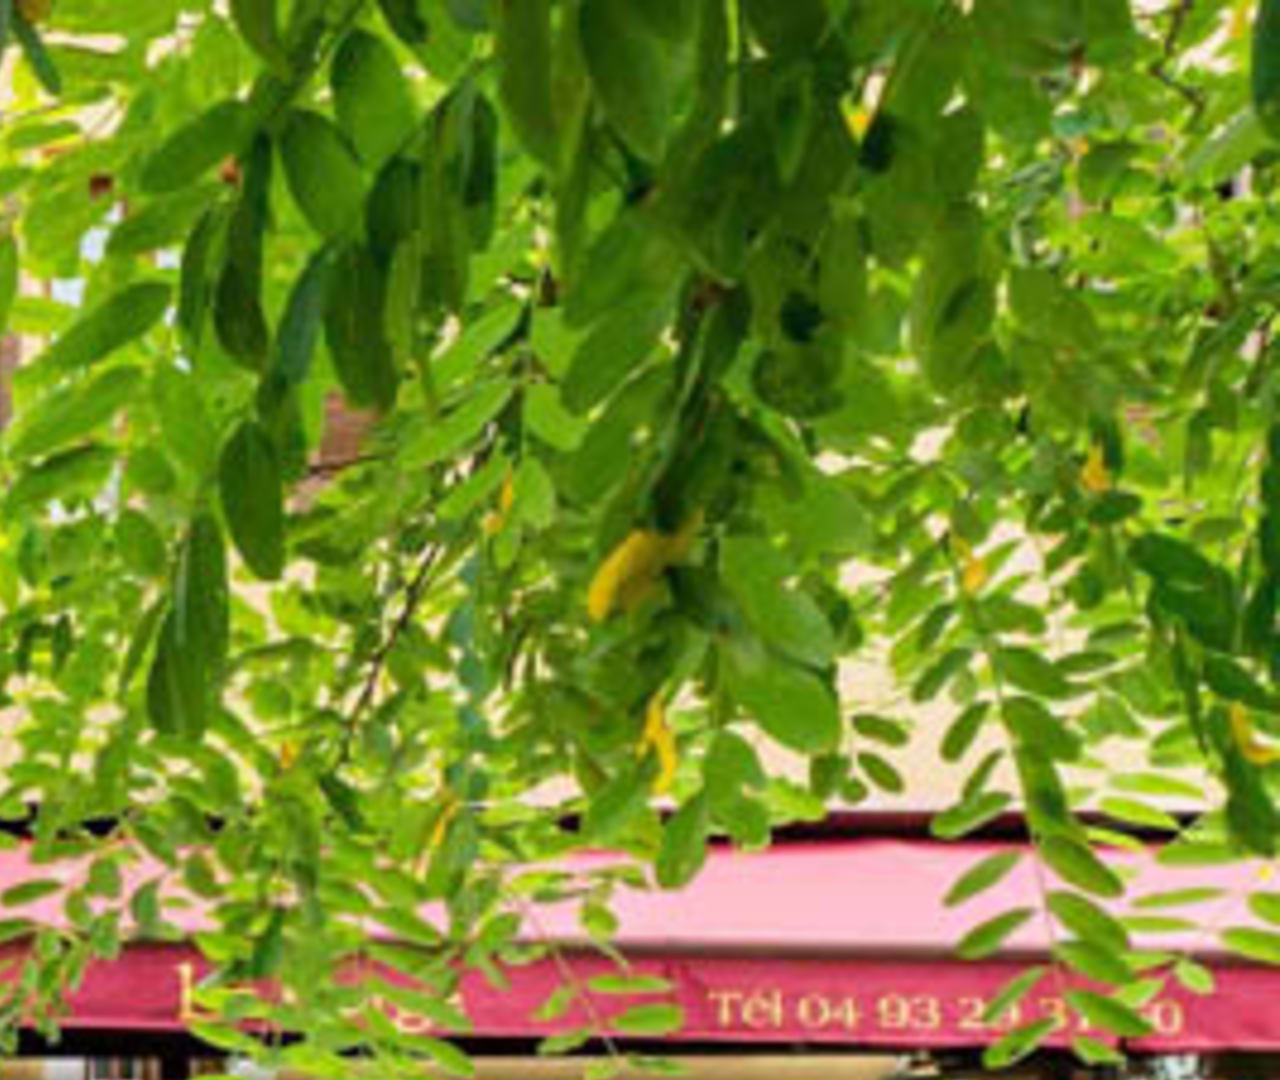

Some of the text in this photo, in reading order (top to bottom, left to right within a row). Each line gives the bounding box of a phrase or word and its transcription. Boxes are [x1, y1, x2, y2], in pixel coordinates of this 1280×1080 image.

[706, 986, 784, 1029] Tél
[796, 993, 861, 1030] 04
[877, 993, 940, 1030] 93
